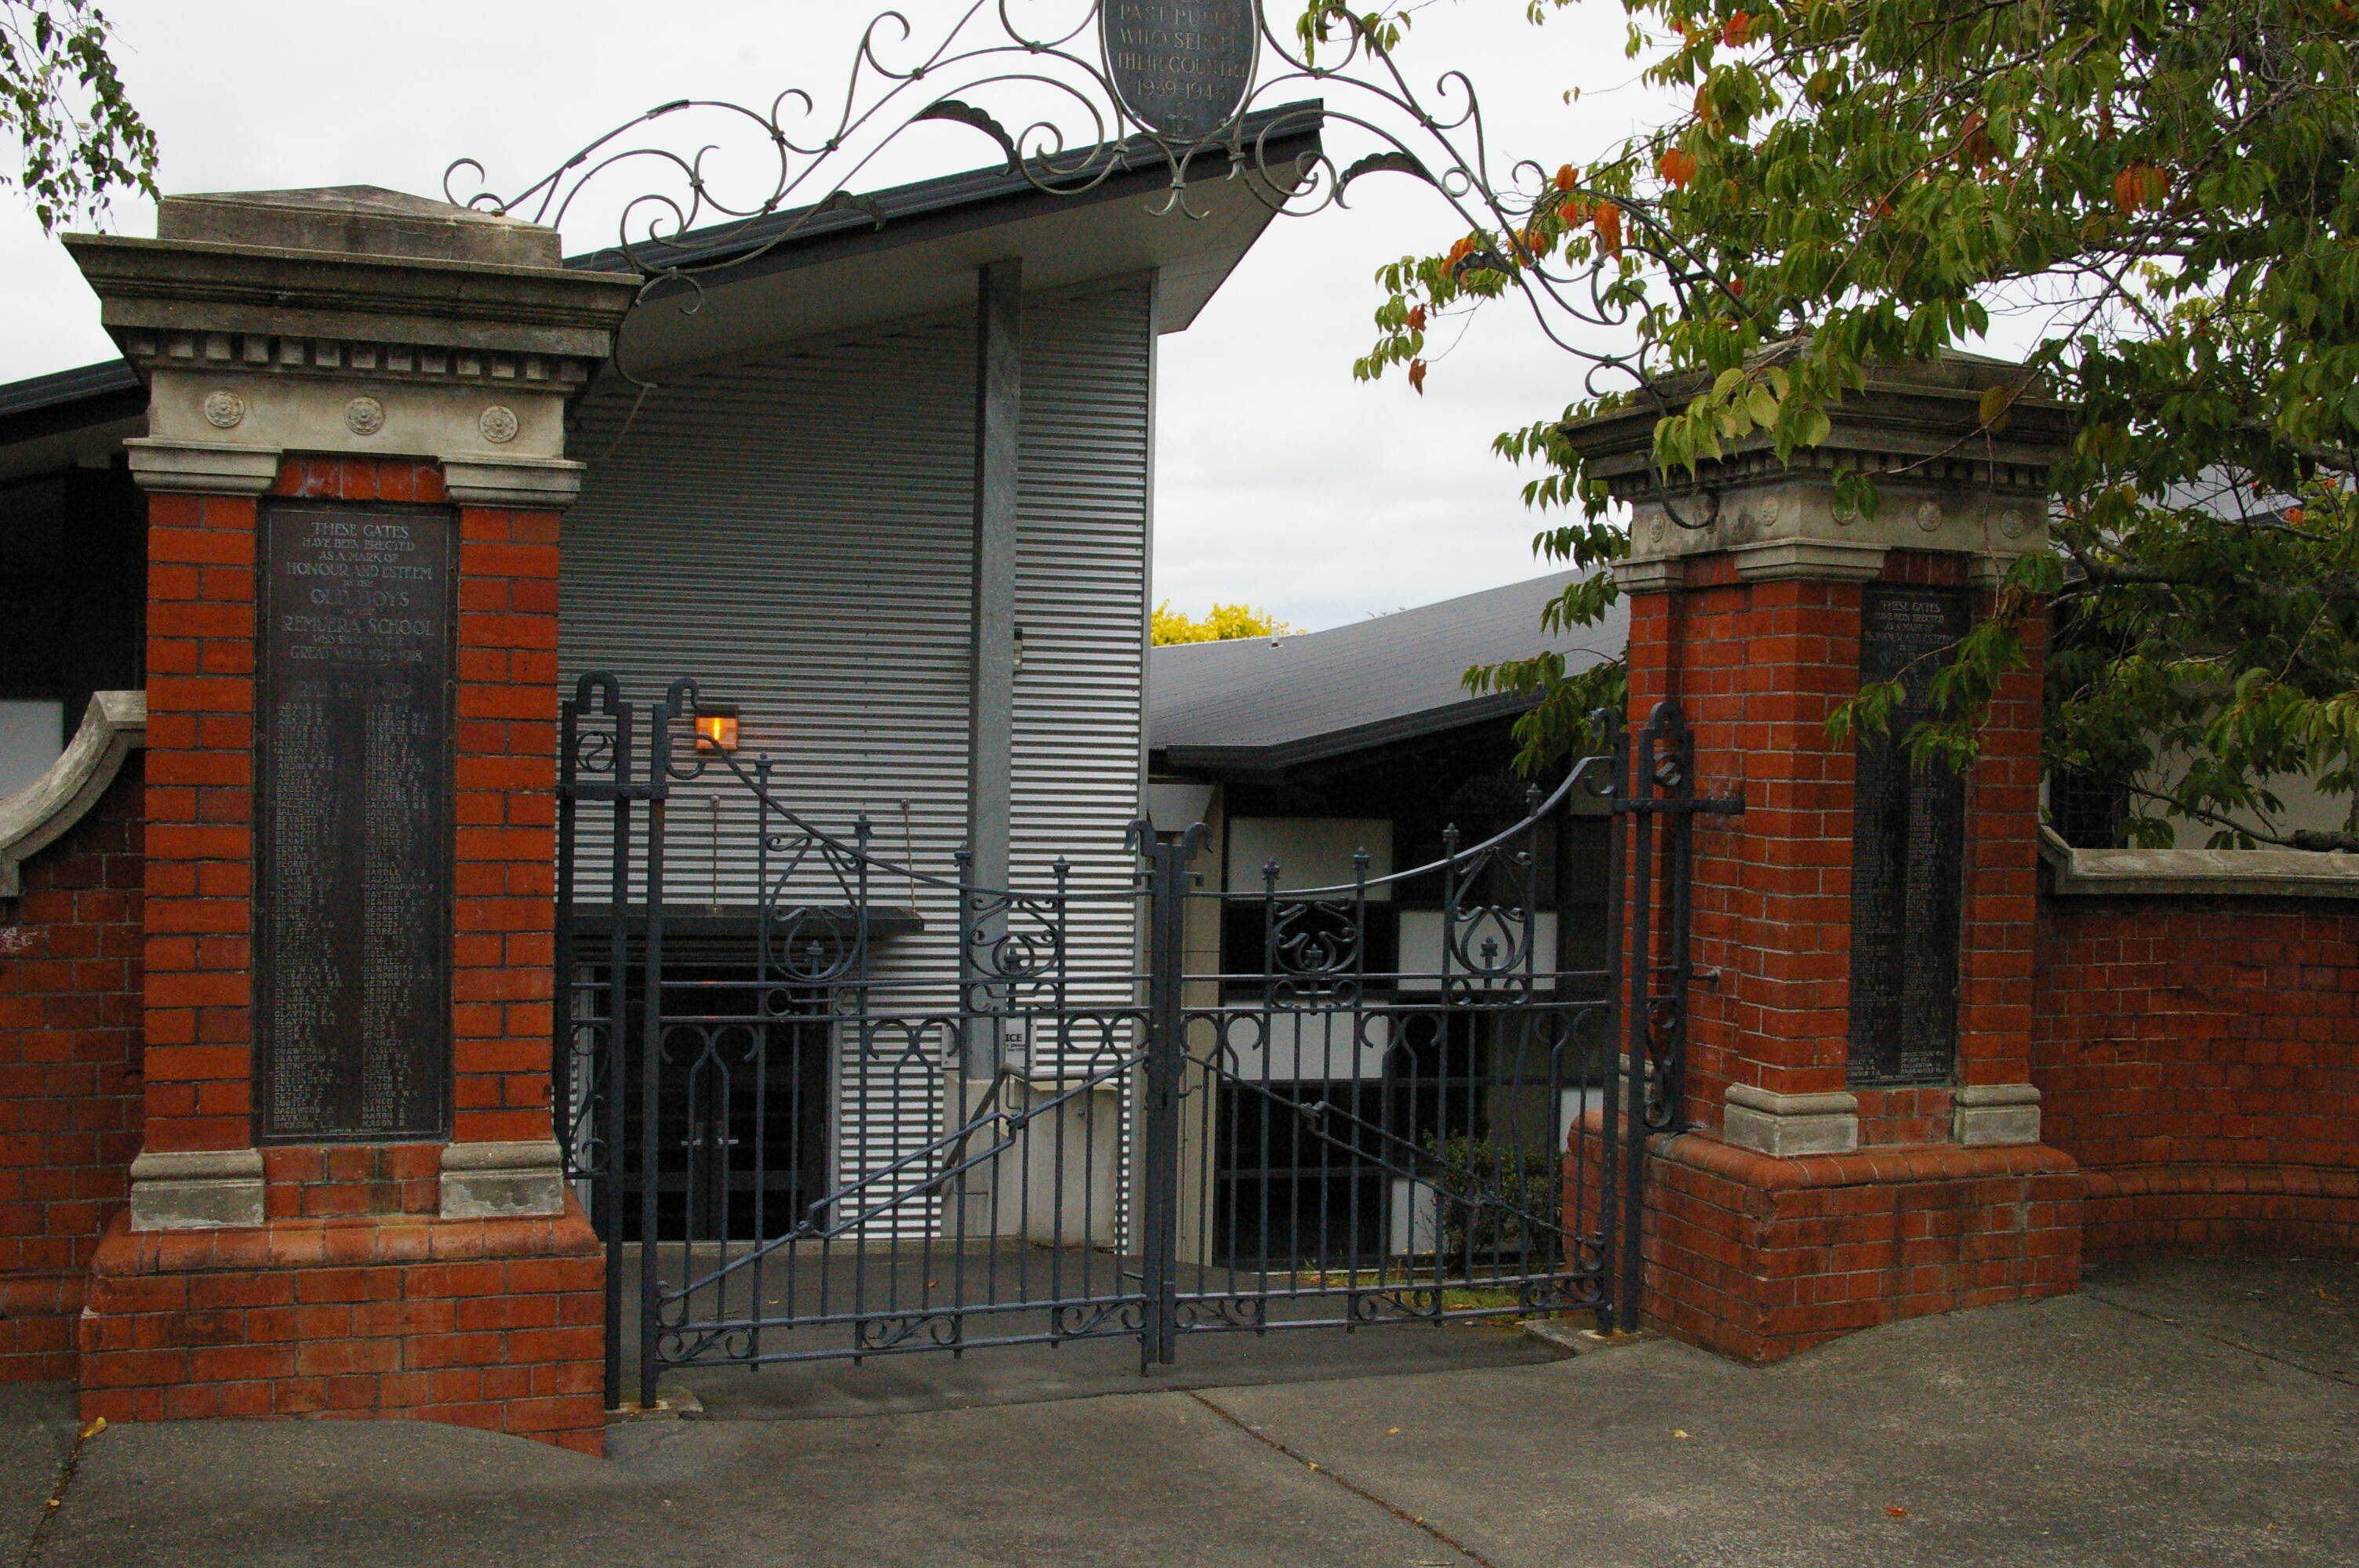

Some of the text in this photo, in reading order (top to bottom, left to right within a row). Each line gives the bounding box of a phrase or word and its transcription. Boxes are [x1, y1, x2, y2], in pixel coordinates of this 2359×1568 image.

[1120, 3, 1166, 22] PAST
[1119, 27, 1168, 47] WHO
[1117, 51, 1166, 72] THEIR
[311, 522, 409, 539] THESE GATES
[302, 537, 415, 552] HAVE BEEN ERECTED
[318, 551, 334, 561] AS
[338, 552, 346, 561] A
[349, 552, 382, 564] MARK
[286, 562, 433, 580] HONOUR AND ESTEEM
[311, 589, 409, 608] OLD BOYS
[1881, 600, 1941, 613] THESE GATES
[280, 615, 435, 637] REMUERA SCHOOL
[289, 645, 332, 660] GREAT
